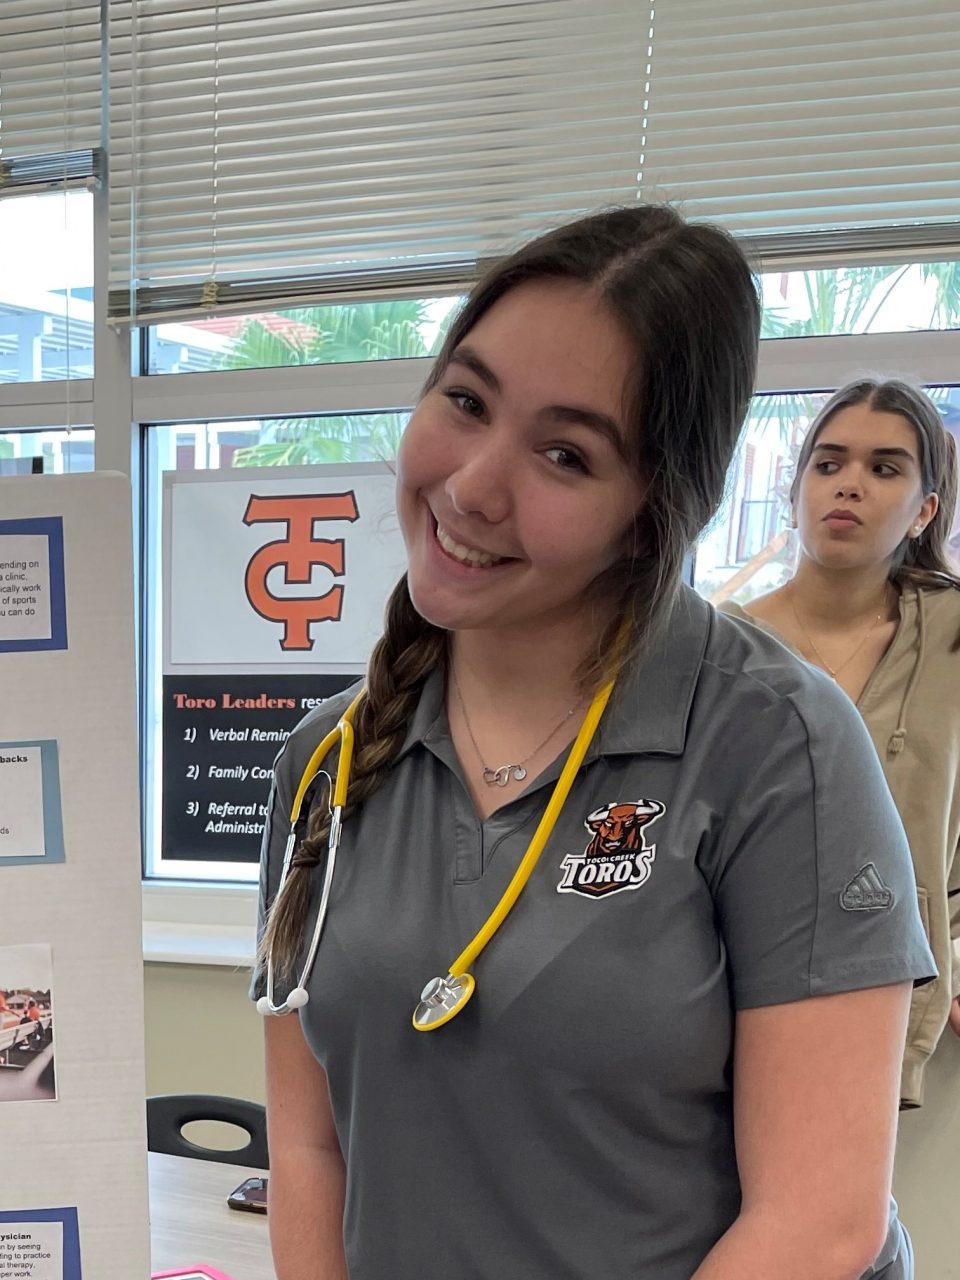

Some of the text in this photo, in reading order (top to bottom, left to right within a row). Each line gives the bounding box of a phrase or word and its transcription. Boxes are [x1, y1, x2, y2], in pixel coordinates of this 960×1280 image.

[29, 560, 39, 568] on
[5, 573, 27, 582] clinic,
[173, 693, 216, 710] Toro
[222, 693, 296, 710] Leaders
[183, 727, 197, 743] 1)
[208, 728, 248, 742] Verbal
[186, 765, 200, 780] 2)
[208, 765, 247, 781] Family
[186, 802, 200, 817] 3)
[208, 802, 257, 816] Referral
[562, 850, 652, 886] TOROS
